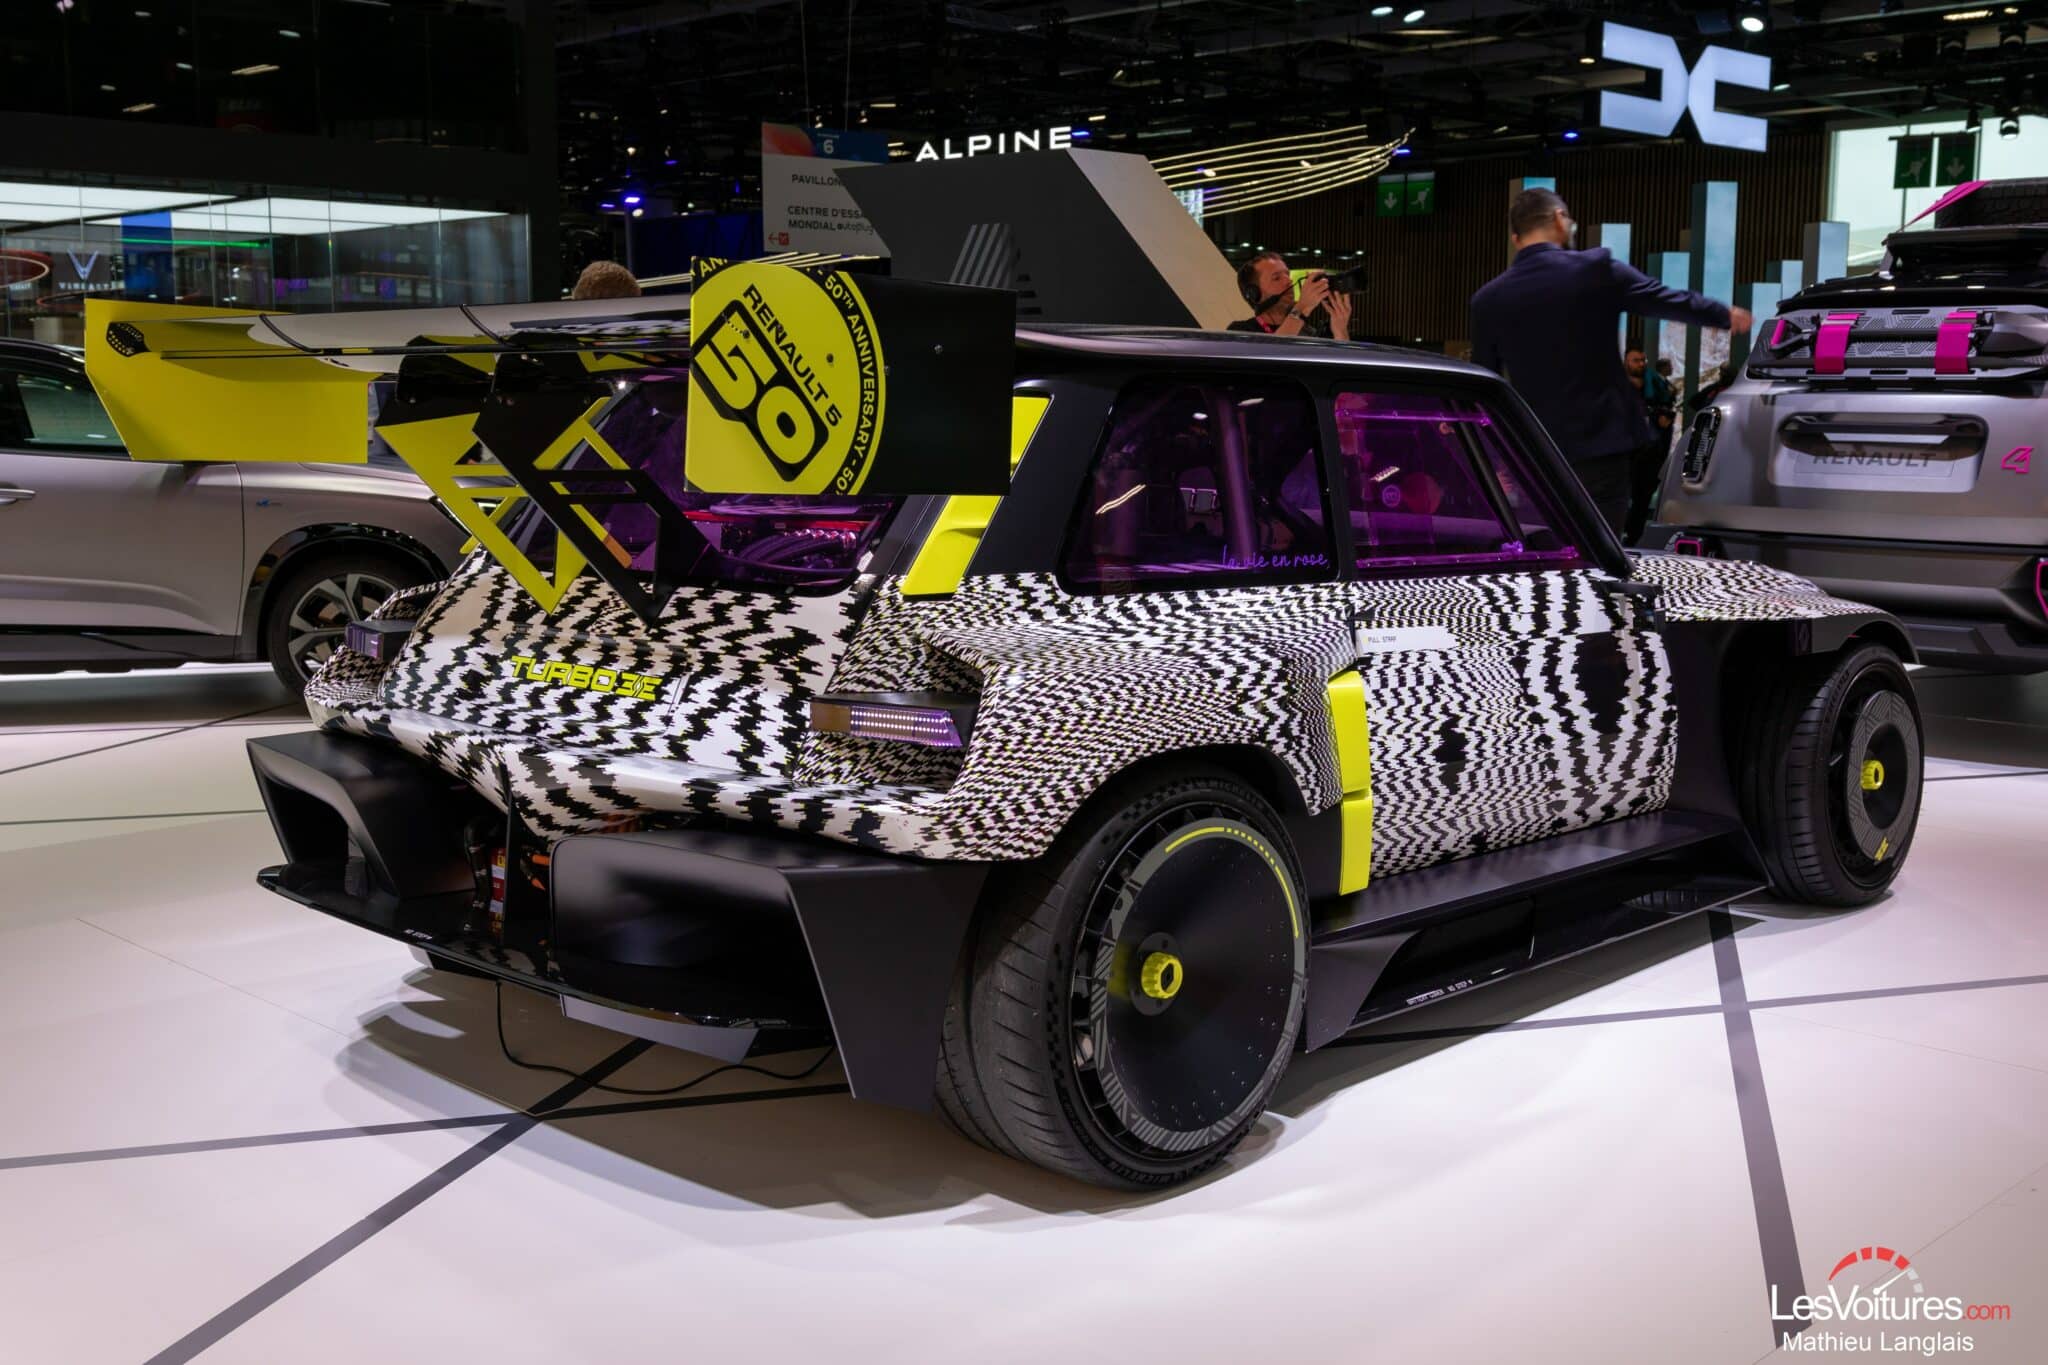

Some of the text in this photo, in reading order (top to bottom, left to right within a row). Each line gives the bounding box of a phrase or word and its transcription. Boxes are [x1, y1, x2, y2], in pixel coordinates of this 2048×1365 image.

[823, 139, 834, 154] 6
[915, 126, 1072, 162] ALPINE
[787, 205, 829, 217] CENTRE
[788, 219, 836, 231] MONDIAL
[743, 283, 843, 427] RENAULT 5
[694, 311, 816, 465] 50
[847, 313, 875, 459] ANNIVERSARY
[1812, 453, 1937, 468] RENAULT
[2001, 446, 2034, 474] 4
[1271, 555, 1292, 567] en
[1294, 553, 1328, 567] rose
